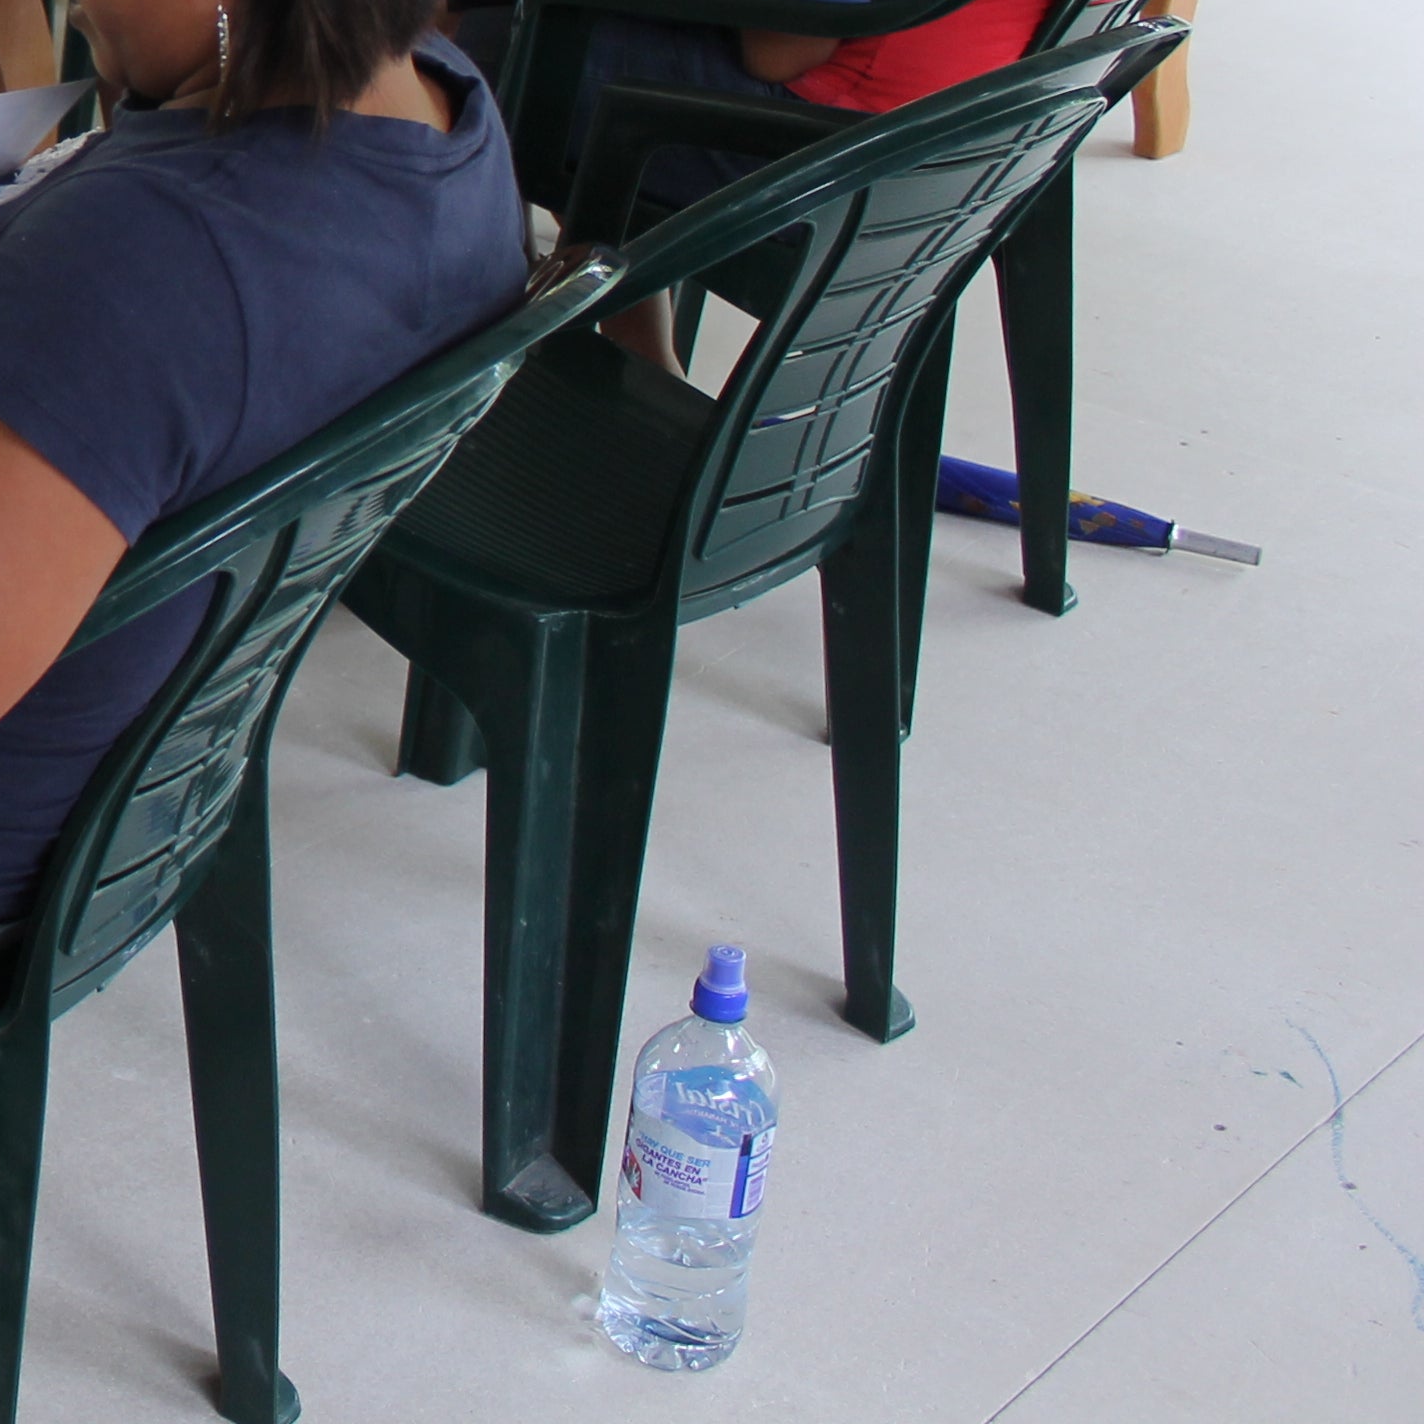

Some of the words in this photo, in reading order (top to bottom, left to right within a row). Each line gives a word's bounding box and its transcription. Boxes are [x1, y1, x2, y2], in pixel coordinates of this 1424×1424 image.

[635, 1138, 681, 1169] GIGANTES
[685, 1165, 701, 1175] EN
[642, 1154, 654, 1167] LA
[660, 1145, 685, 1160] QUE
[687, 1156, 712, 1167] SER
